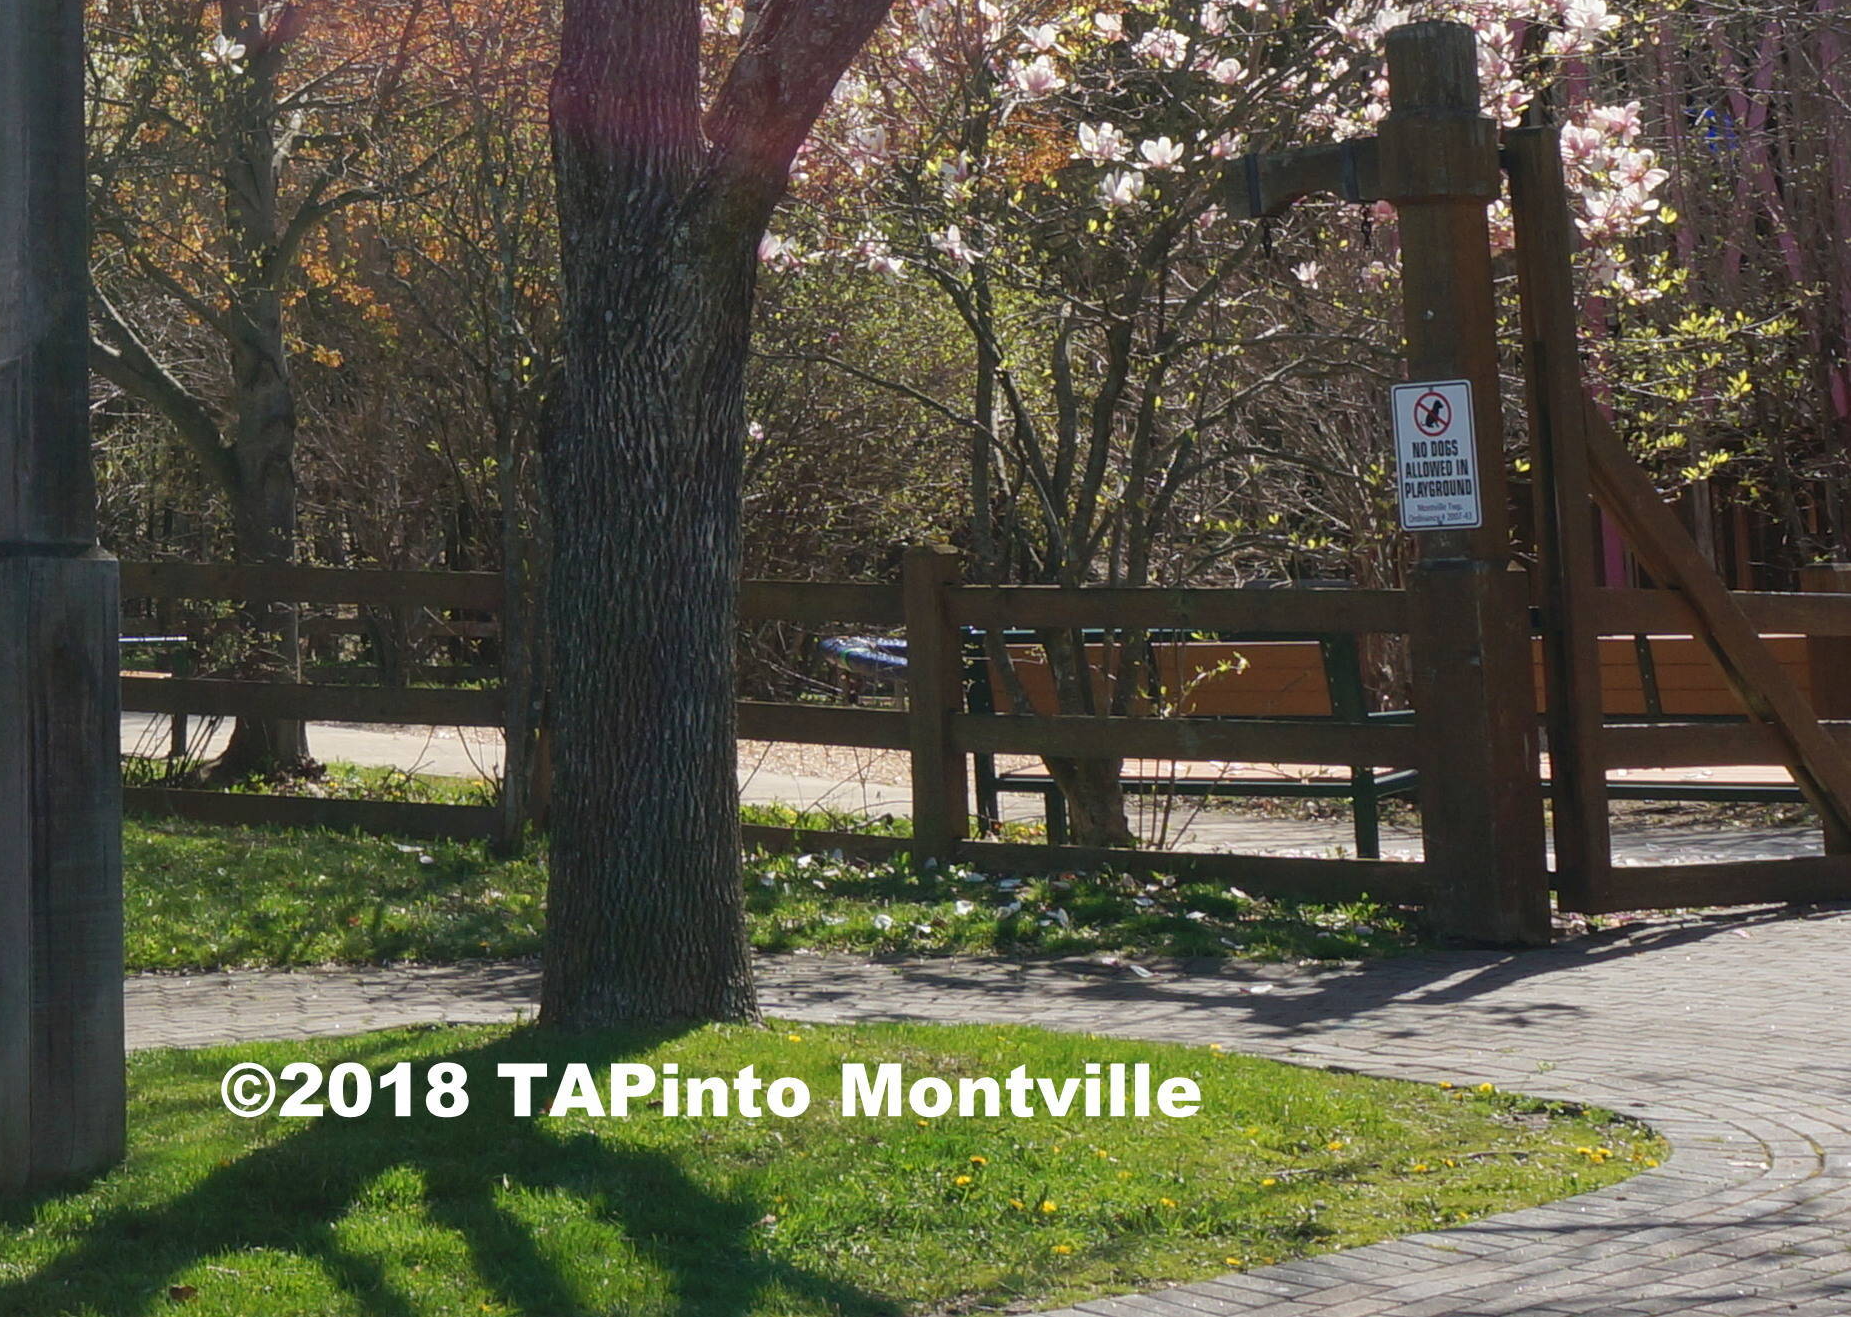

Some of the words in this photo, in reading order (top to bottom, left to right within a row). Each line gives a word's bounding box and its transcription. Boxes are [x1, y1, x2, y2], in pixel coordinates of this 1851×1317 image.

[1412, 441, 1427, 458] NO
[1431, 440, 1458, 457] DOGS
[1406, 460, 1452, 478] ALLOWED
[1456, 459, 1468, 475] IN
[1405, 479, 1471, 498] PLAYGROUND
